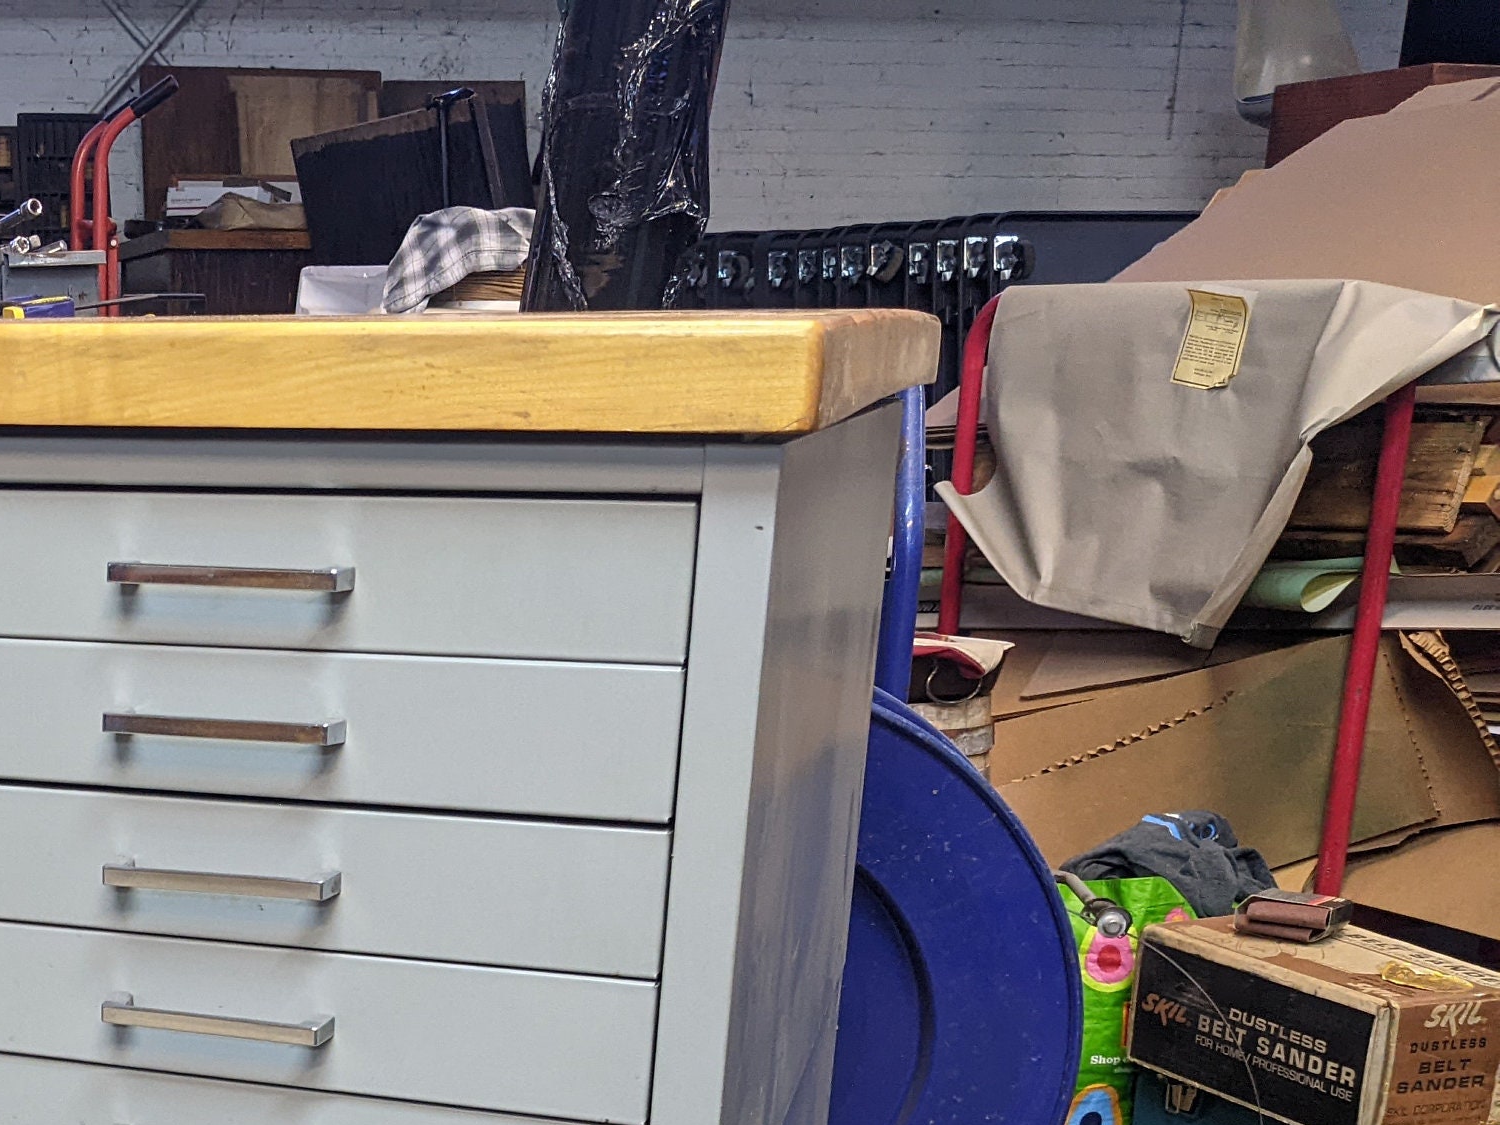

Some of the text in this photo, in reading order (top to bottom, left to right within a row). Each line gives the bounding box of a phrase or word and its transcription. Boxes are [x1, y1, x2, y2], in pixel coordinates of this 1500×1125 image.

[1228, 1007, 1328, 1054] DUSTLESS
[1197, 1014, 1357, 1088] BELT SANDER
[1409, 1037, 1487, 1054] DUSTLESS
[1090, 1055, 1121, 1066] Shop
[1195, 1034, 1214, 1050] FOR
[1330, 1083, 1354, 1103] USE
[1418, 1058, 1472, 1075] BELT
[1396, 1074, 1485, 1094] SANDER
